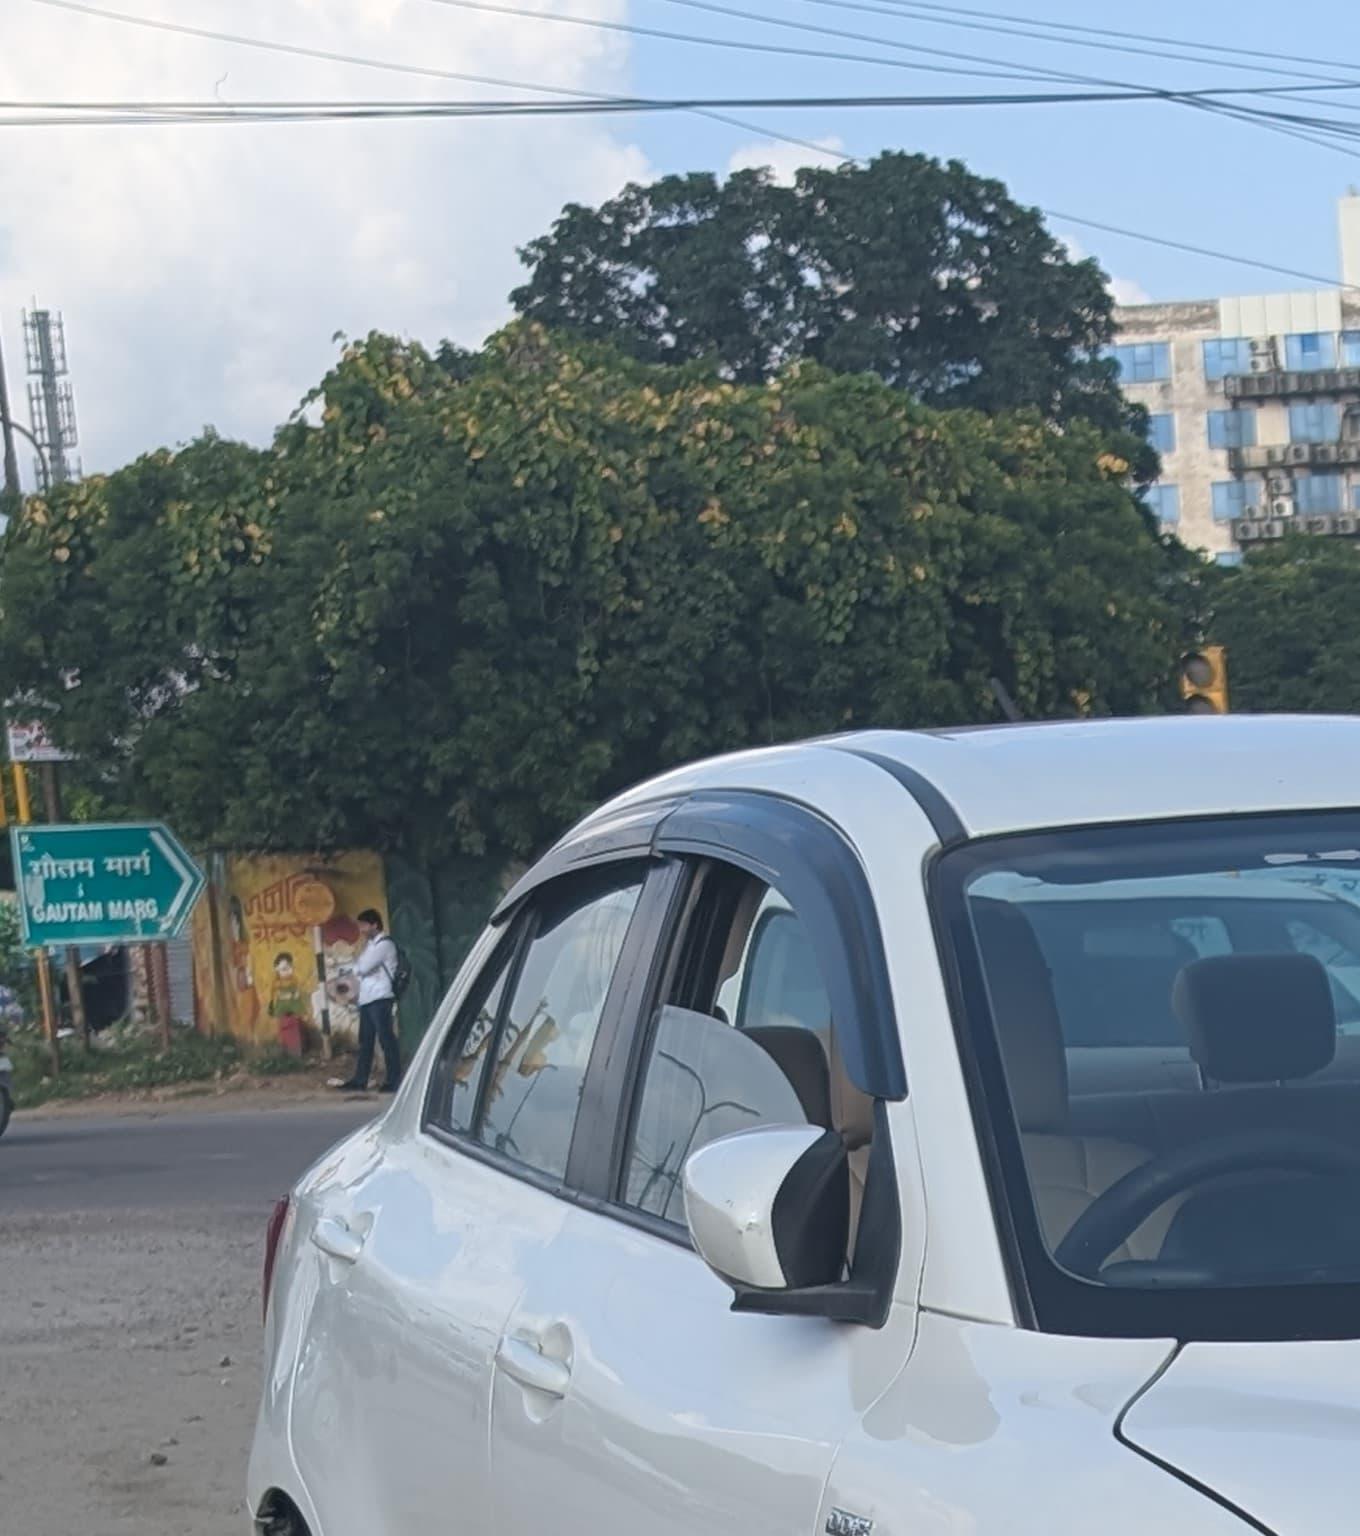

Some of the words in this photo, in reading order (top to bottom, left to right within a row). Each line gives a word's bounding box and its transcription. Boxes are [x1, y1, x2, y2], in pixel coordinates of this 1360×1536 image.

[28, 852, 95, 880] गौतम
[103, 849, 151, 876] मार्ग
[32, 901, 103, 923] GAUTAM
[108, 898, 159, 921] MARG
